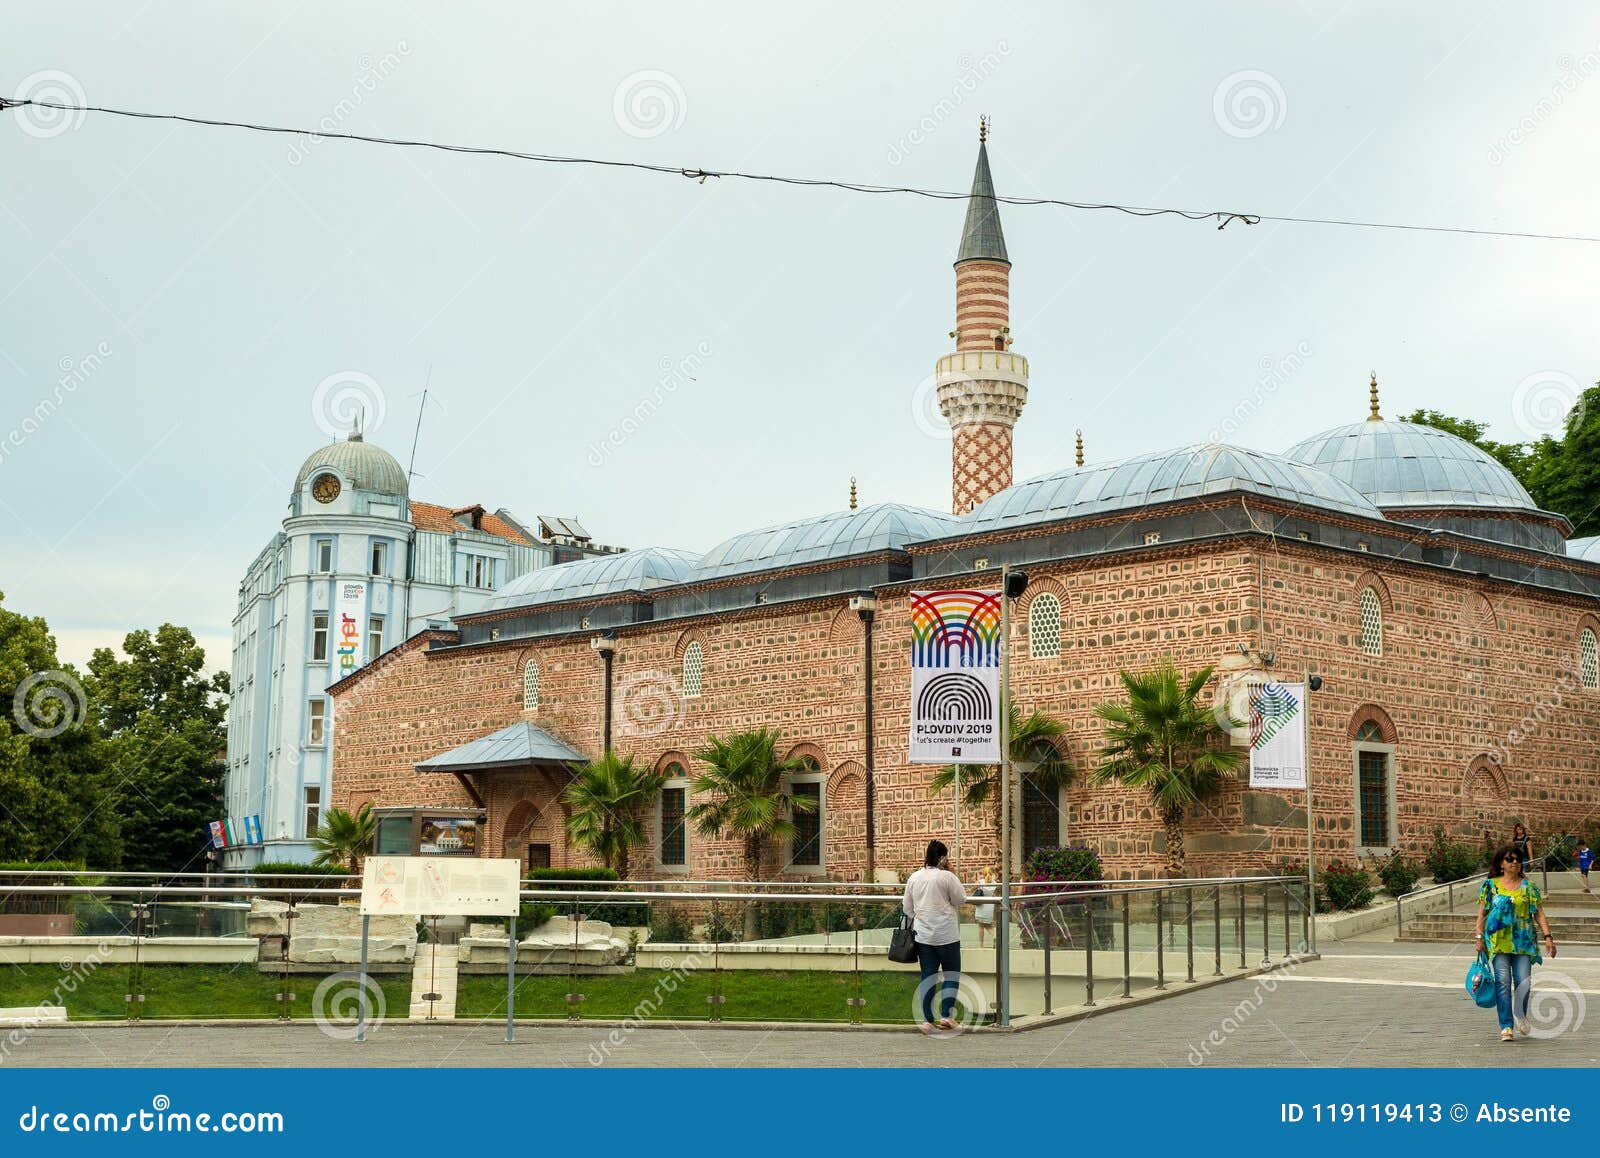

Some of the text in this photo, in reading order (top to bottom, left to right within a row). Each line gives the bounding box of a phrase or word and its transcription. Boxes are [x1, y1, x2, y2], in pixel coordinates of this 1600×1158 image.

[337, 612, 359, 678] gether
[917, 724, 992, 734] PLOVDIV 2019
[956, 736, 992, 745] #together
